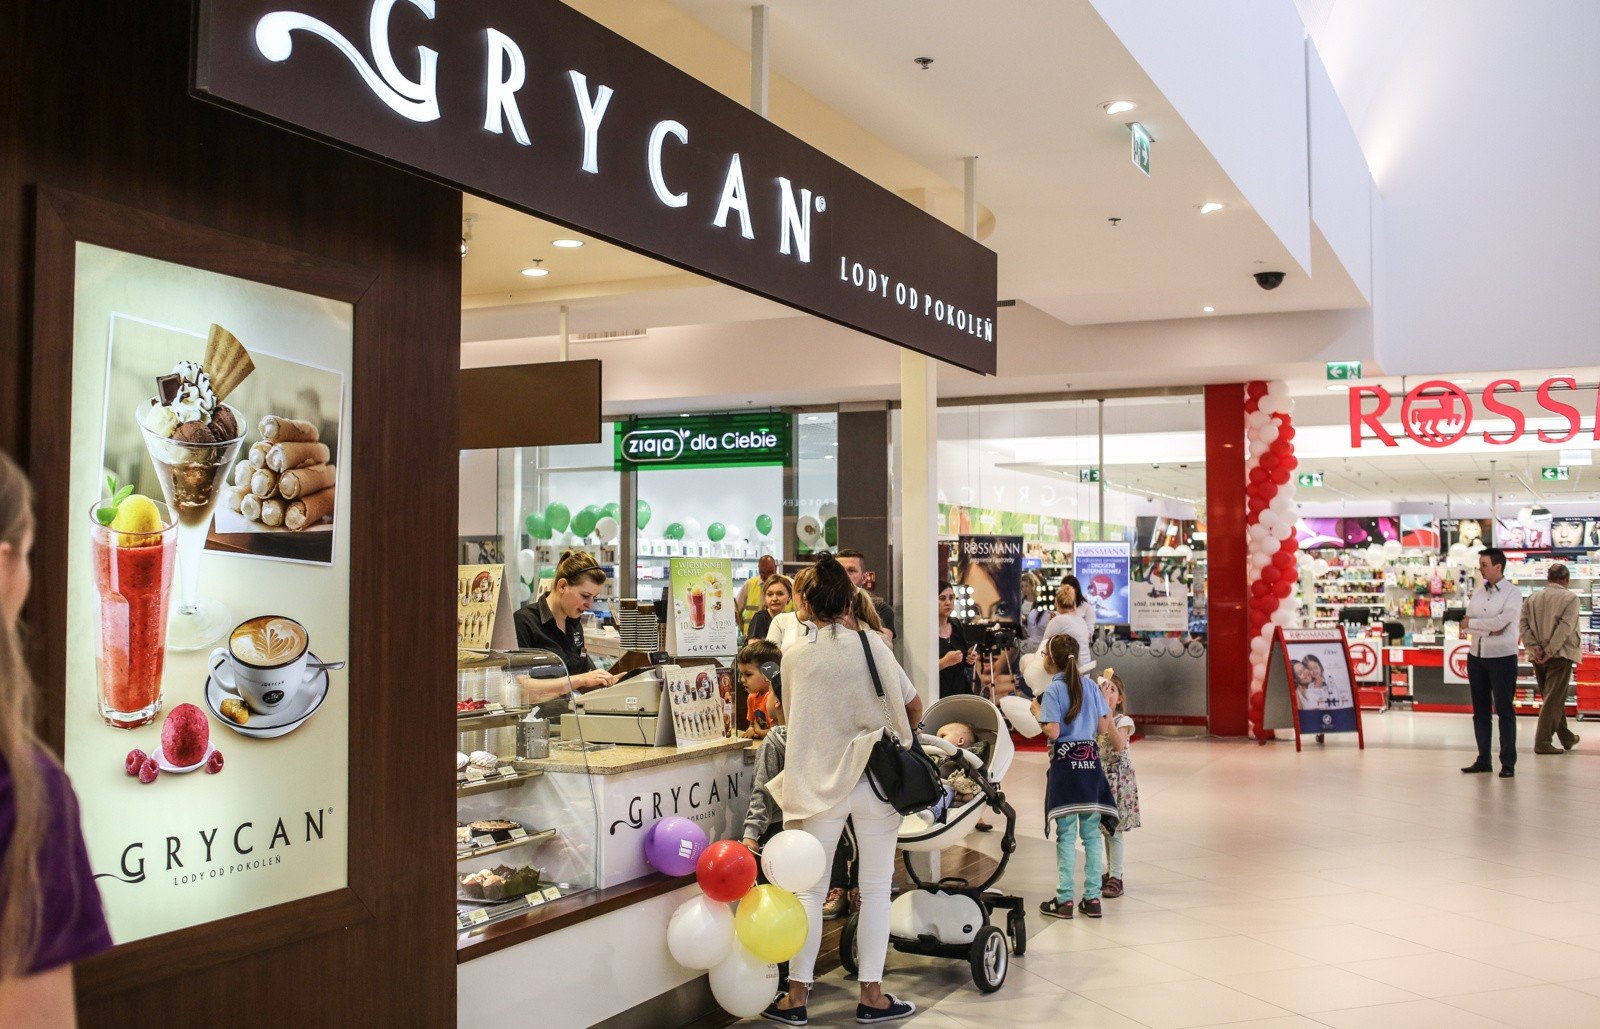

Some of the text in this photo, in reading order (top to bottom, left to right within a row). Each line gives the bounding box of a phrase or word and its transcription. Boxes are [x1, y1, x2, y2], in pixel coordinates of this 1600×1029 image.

[840, 256, 992, 342] LODY OD POKOLEŃ
[1349, 377, 1600, 448] ROSS
[629, 430, 777, 457] ziaja dla Ciebie
[963, 541, 1020, 555] ROSSMANN
[1077, 547, 1126, 556] ROSSMANN
[688, 643, 727, 652] GRYCAN
[1071, 761, 1096, 769] PARK
[174, 854, 281, 886] LODY OD POKOLEŃ
